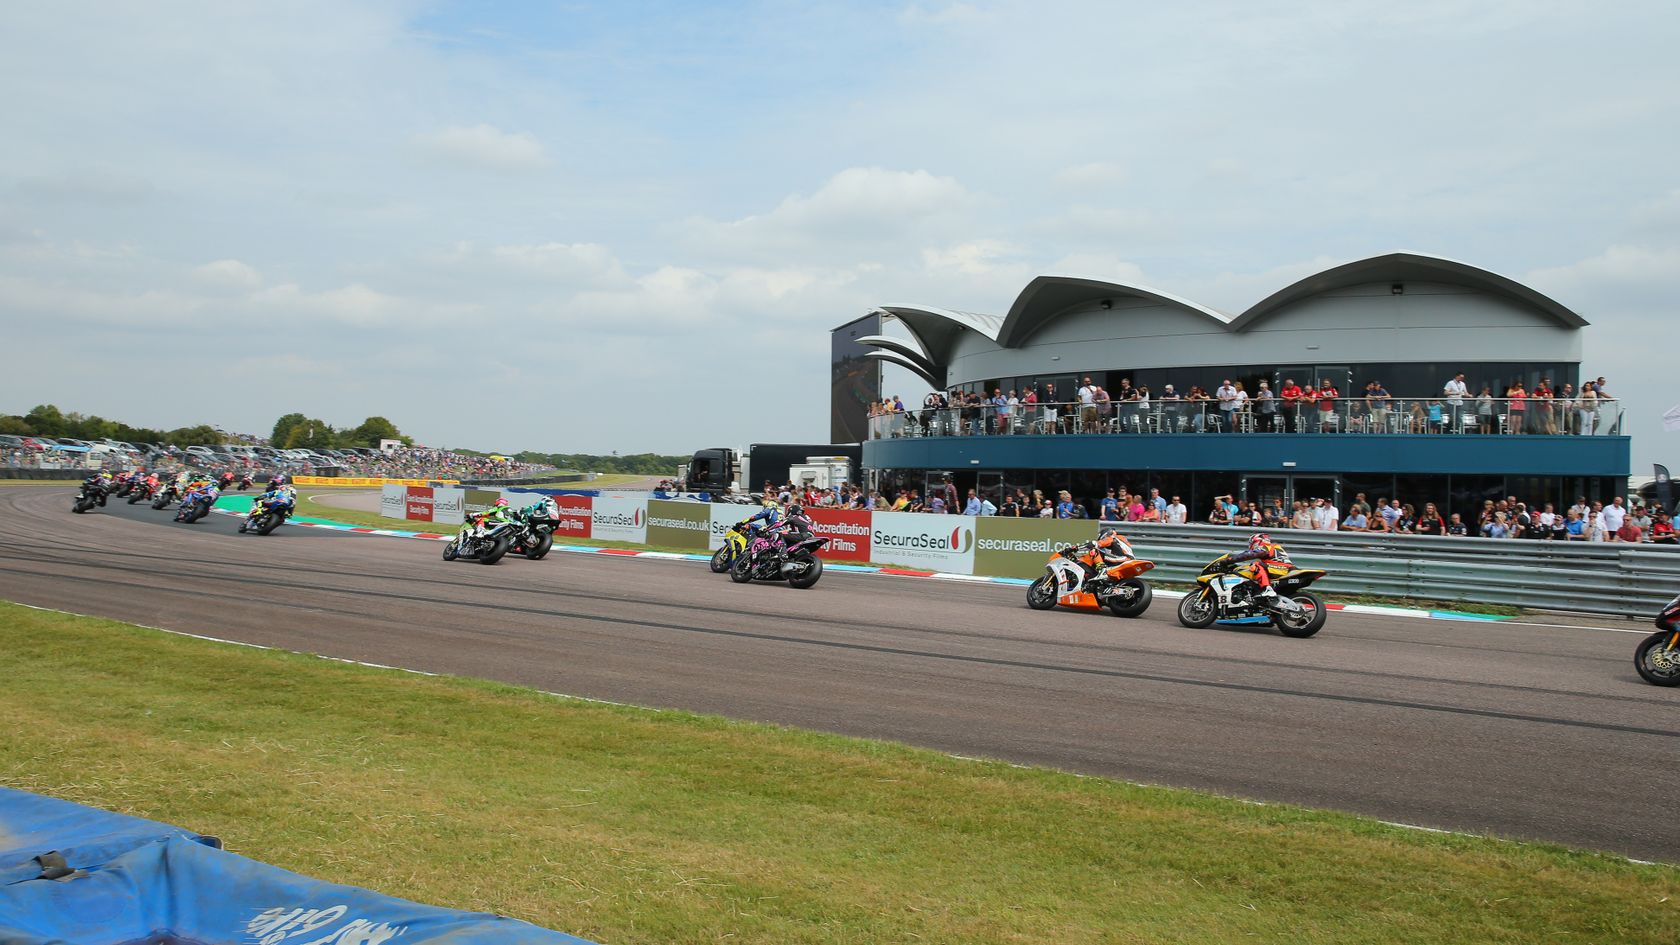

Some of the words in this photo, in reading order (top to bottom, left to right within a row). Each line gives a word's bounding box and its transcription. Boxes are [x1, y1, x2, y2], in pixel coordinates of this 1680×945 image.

[594, 511, 634, 526] SecuraSeal
[647, 517, 711, 532] securaseal.co.uk
[812, 520, 870, 536] Accreditation
[832, 538, 857, 552] Films
[873, 530, 950, 550] SecuraSeal
[978, 538, 1092, 555] securaseal.co
